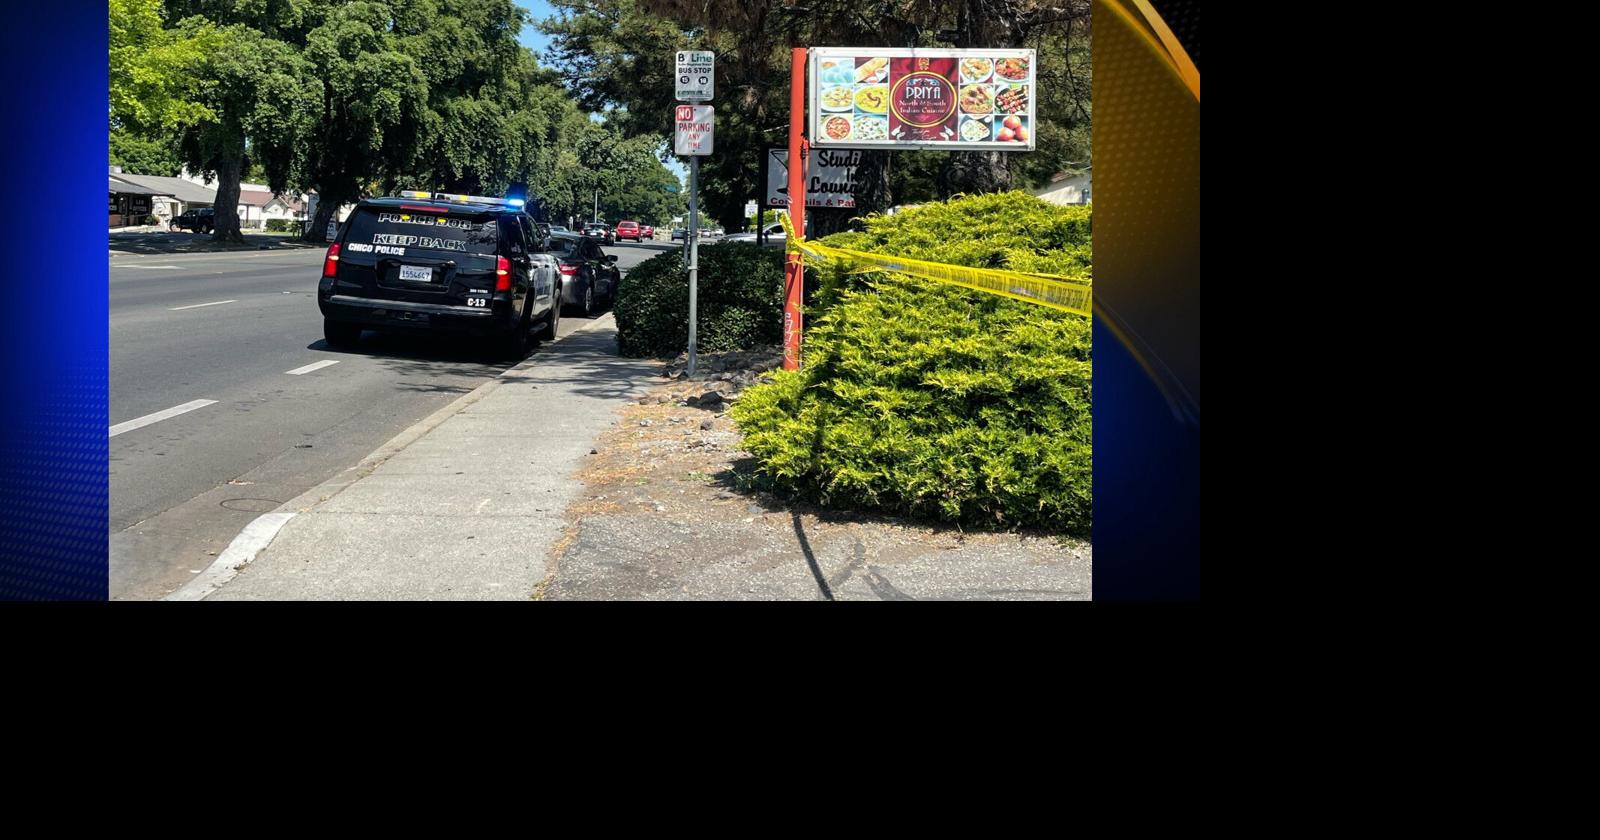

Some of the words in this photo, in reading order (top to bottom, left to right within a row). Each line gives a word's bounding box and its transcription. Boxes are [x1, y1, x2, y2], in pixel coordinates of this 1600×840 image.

[678, 53, 685, 62] B
[691, 53, 712, 63] Line
[905, 86, 941, 99] PRIYA
[678, 108, 691, 117] NO
[678, 122, 710, 132] PARKING
[817, 150, 861, 168] Studi
[807, 176, 858, 199] Loung
[838, 199, 856, 207] Pat
[377, 212, 435, 226] POLICE
[435, 217, 472, 230] DOG
[372, 233, 418, 246] KEEP
[418, 236, 467, 251] BACK
[347, 242, 373, 253] CHICO
[374, 245, 406, 256] POLICE
[467, 297, 486, 307] C-13
